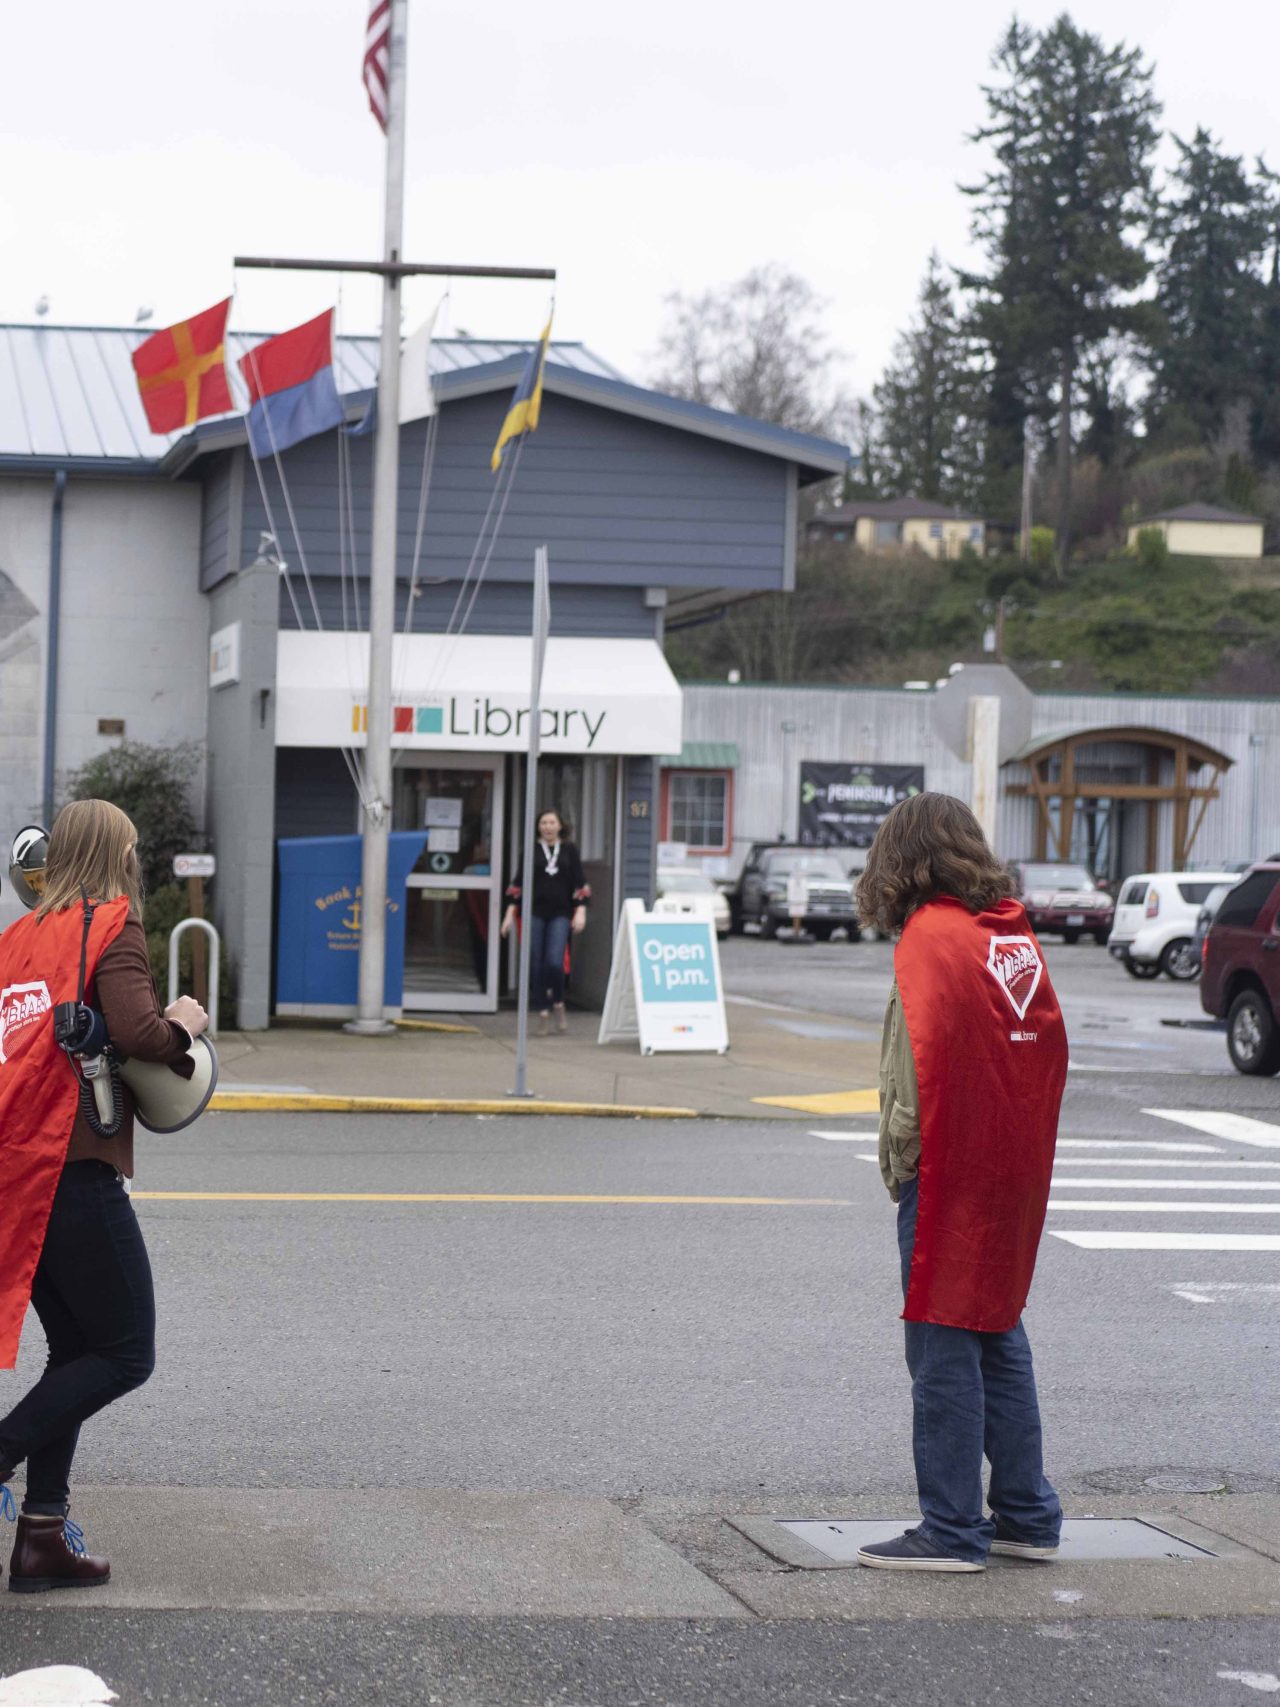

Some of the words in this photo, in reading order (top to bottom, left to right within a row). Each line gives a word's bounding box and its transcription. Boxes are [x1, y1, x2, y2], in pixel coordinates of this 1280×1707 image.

[450, 697, 607, 747] Library
[827, 783, 896, 806] PENINSULA
[643, 939, 705, 965] Open
[651, 964, 662, 985] 1
[665, 968, 710, 990] p.m.
